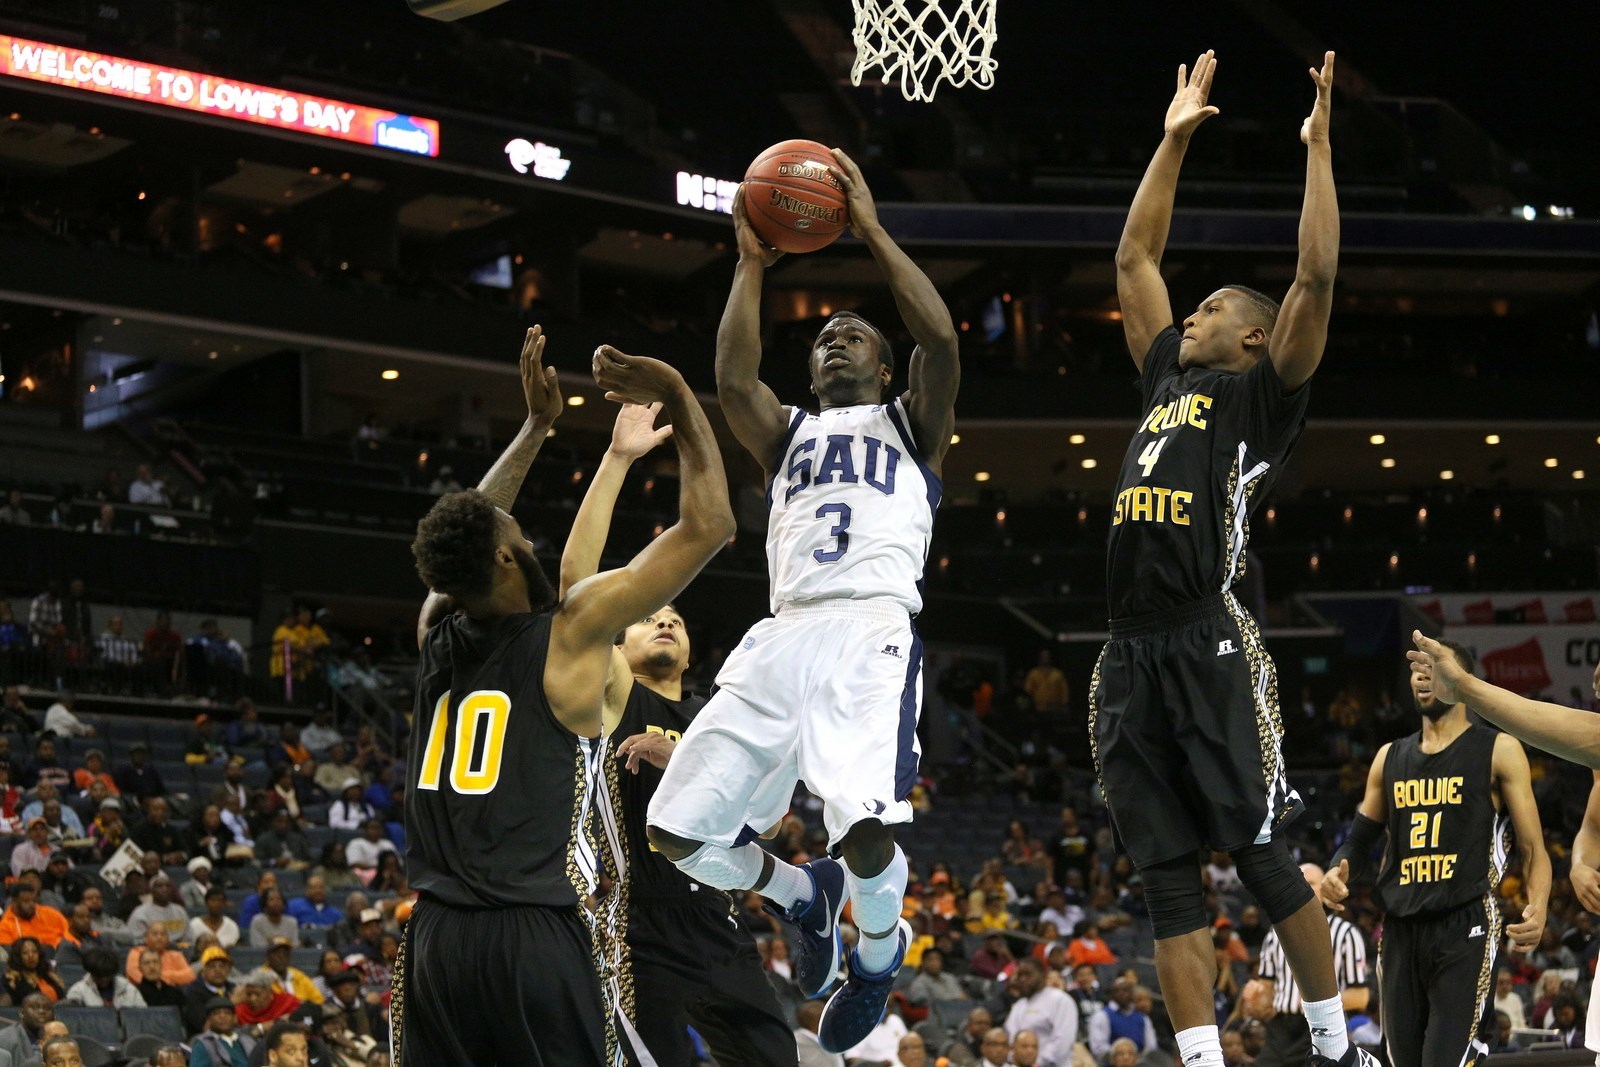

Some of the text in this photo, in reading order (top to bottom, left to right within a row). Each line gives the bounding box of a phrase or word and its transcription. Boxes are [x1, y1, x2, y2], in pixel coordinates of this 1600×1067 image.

[11, 43, 355, 133] WELCOME TO LOWE'S DAY
[769, 187, 843, 224] SPALDING
[785, 434, 901, 506] SAU
[1137, 436, 1169, 477] 4
[1113, 486, 1193, 526] STATE
[813, 502, 852, 564] 3
[417, 690, 511, 795] 10
[1394, 776, 1463, 809] BOWIE
[1410, 811, 1442, 849] 21
[1400, 854, 1457, 885] STATE
